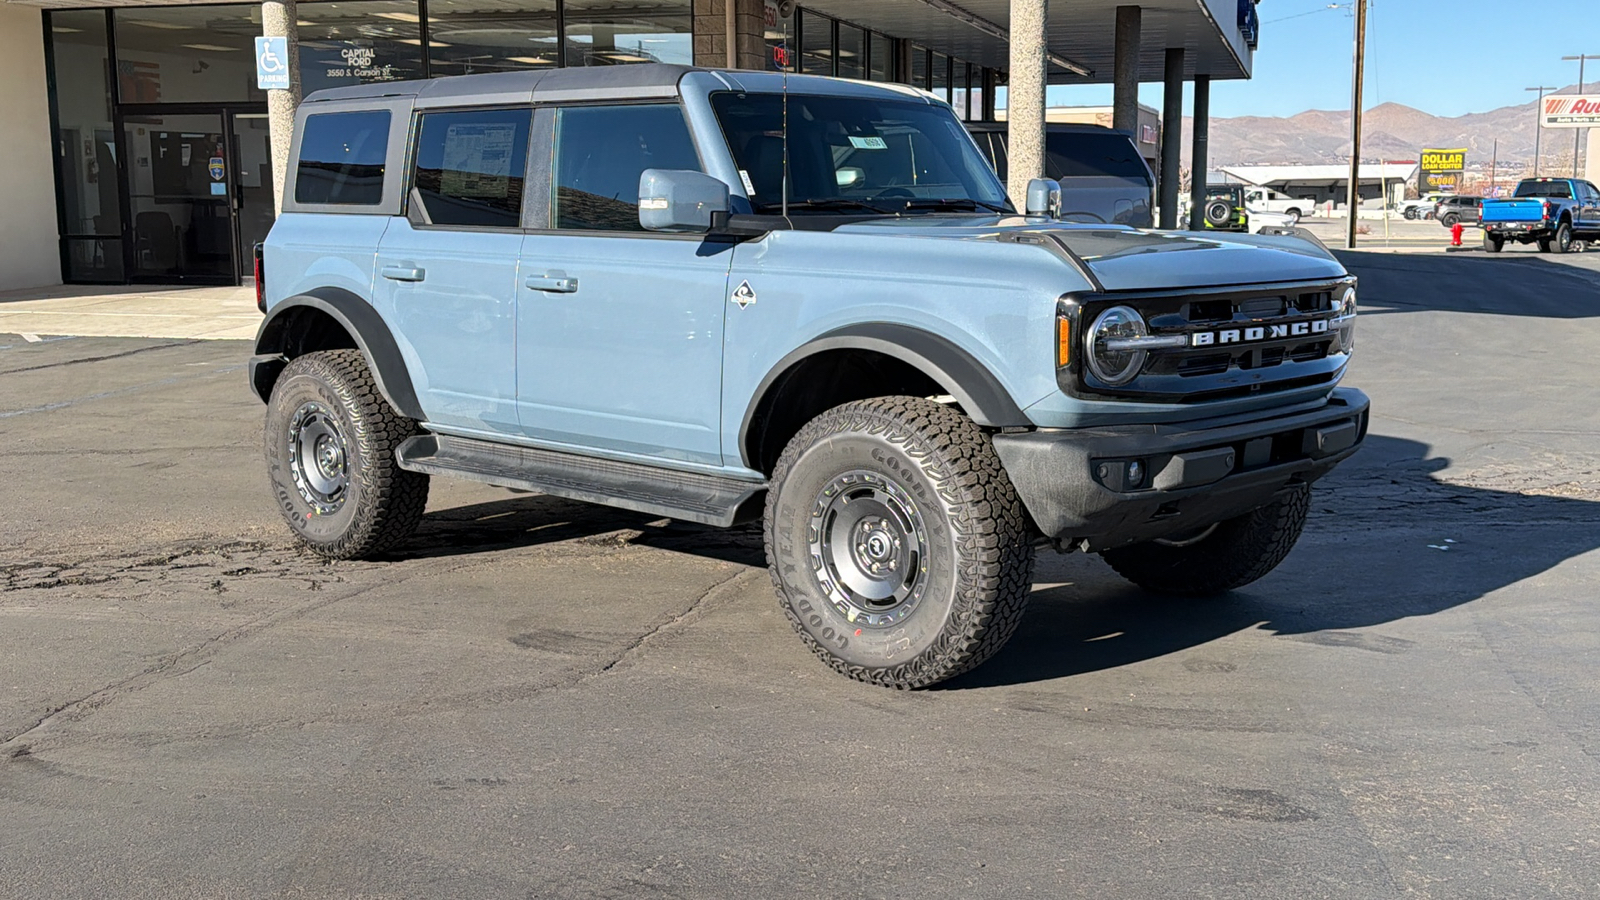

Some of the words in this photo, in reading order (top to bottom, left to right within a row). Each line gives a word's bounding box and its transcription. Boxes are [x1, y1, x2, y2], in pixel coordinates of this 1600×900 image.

[341, 48, 375, 58] CAPITAL
[347, 57, 371, 66] FORD
[326, 69, 345, 77] 3550
[354, 68, 380, 77] Carson
[260, 74, 287, 83] PARKING
[1422, 154, 1463, 164] DOLLAR
[1192, 320, 1328, 346] BRONCO
[778, 503, 849, 650] GOODYEAR
